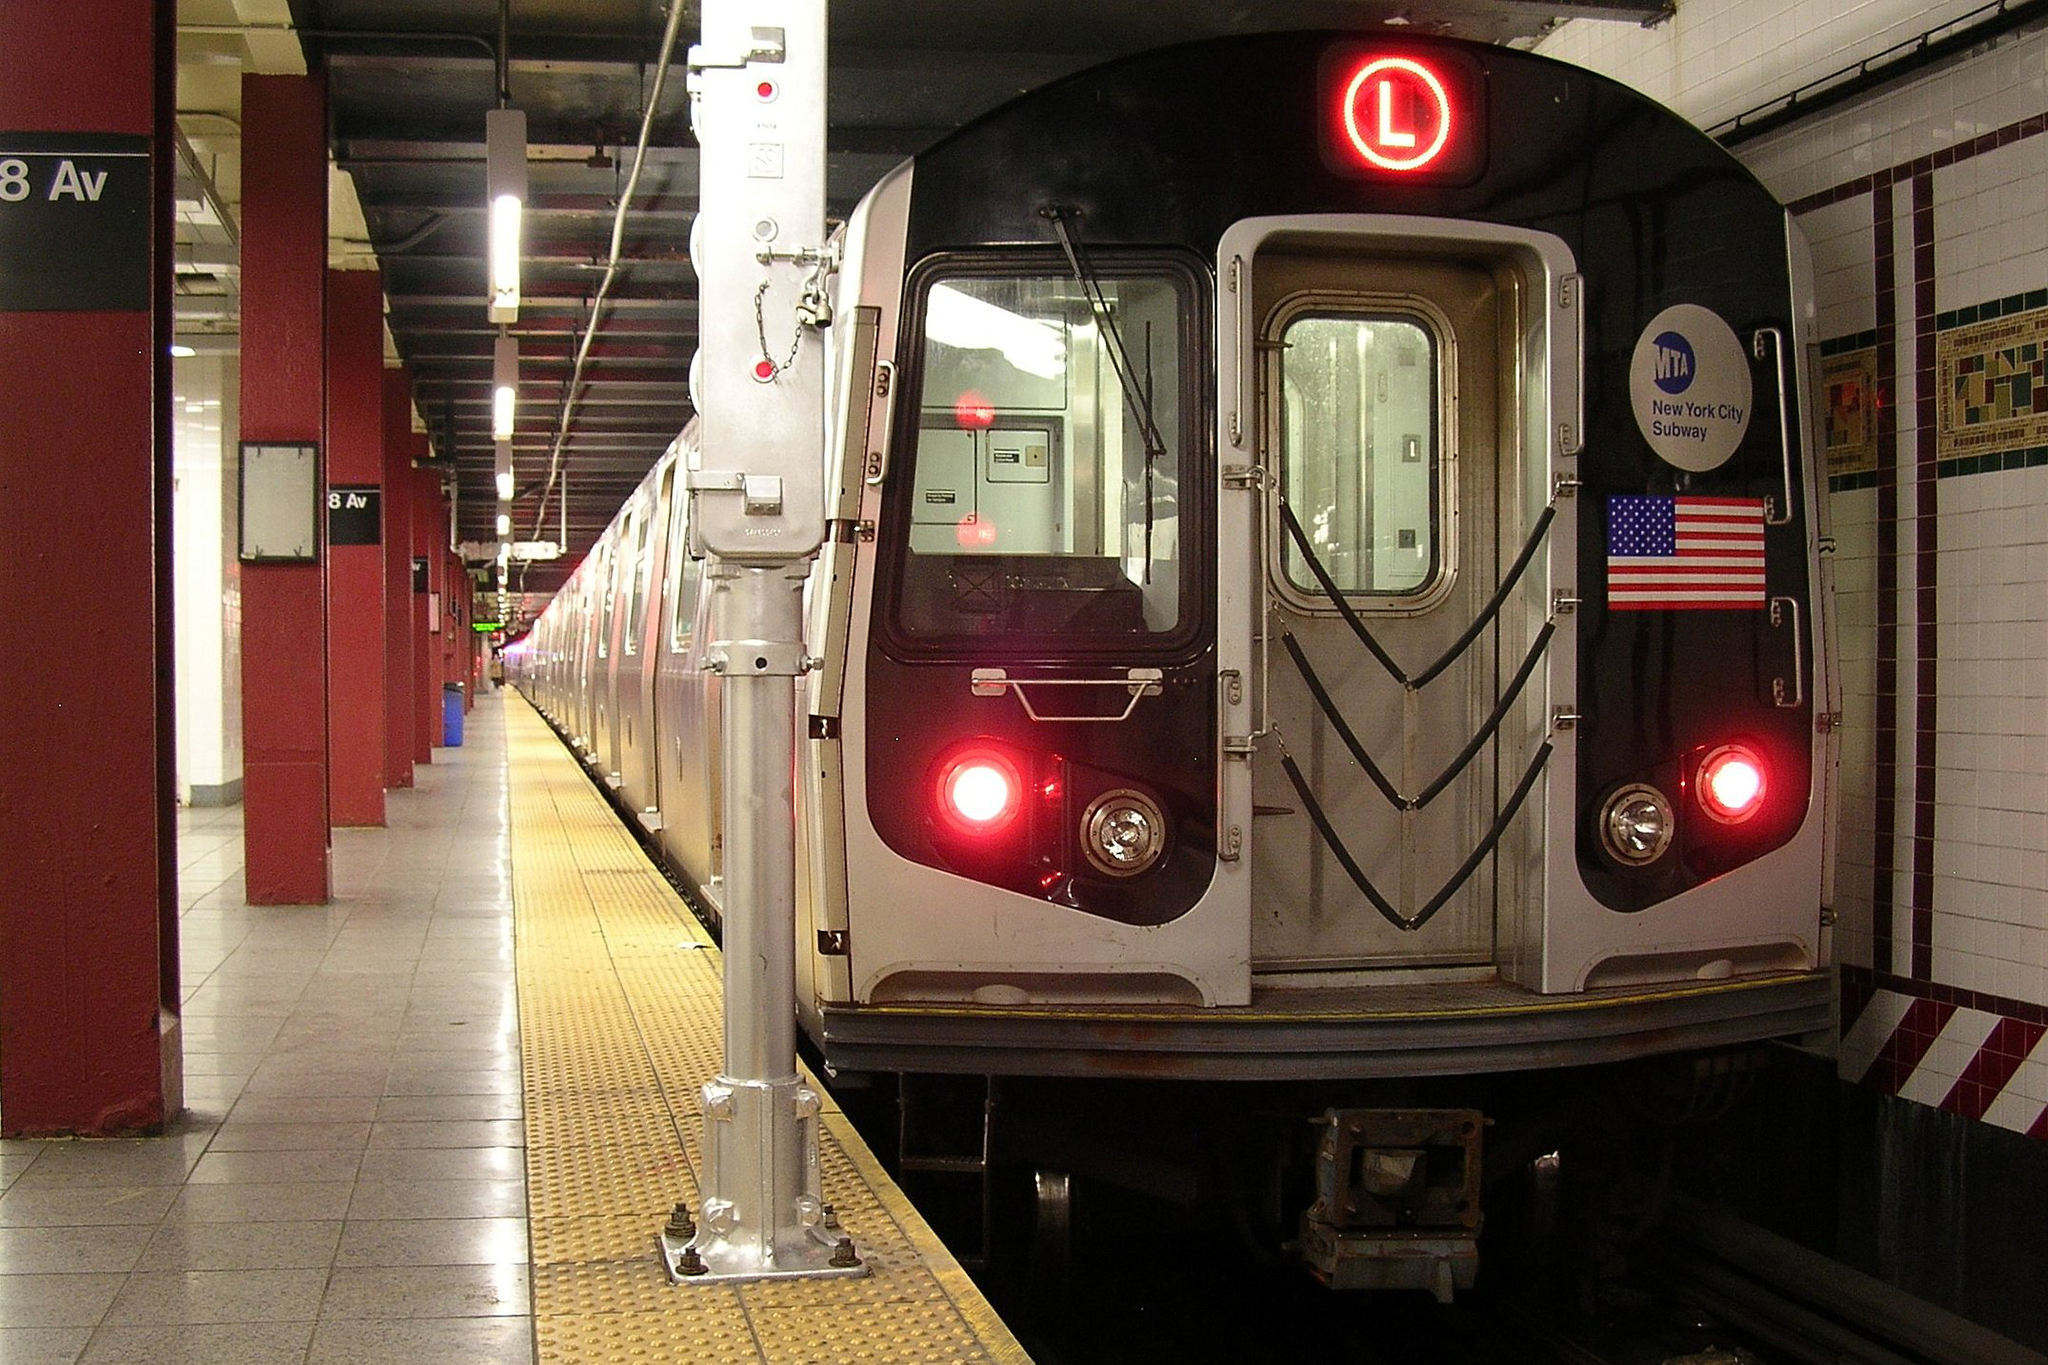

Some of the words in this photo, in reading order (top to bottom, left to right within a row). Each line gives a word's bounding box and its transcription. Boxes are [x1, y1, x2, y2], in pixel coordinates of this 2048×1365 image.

[1379, 80, 1416, 148] L
[0, 159, 31, 202] 8
[48, 160, 108, 202] Av
[1653, 345, 1689, 380] MTA
[1652, 399, 1683, 416] New
[1686, 401, 1716, 419] York
[1718, 403, 1743, 425] City
[1652, 420, 1707, 442] Subway
[328, 493, 341, 510] 8
[345, 493, 367, 509] Av
